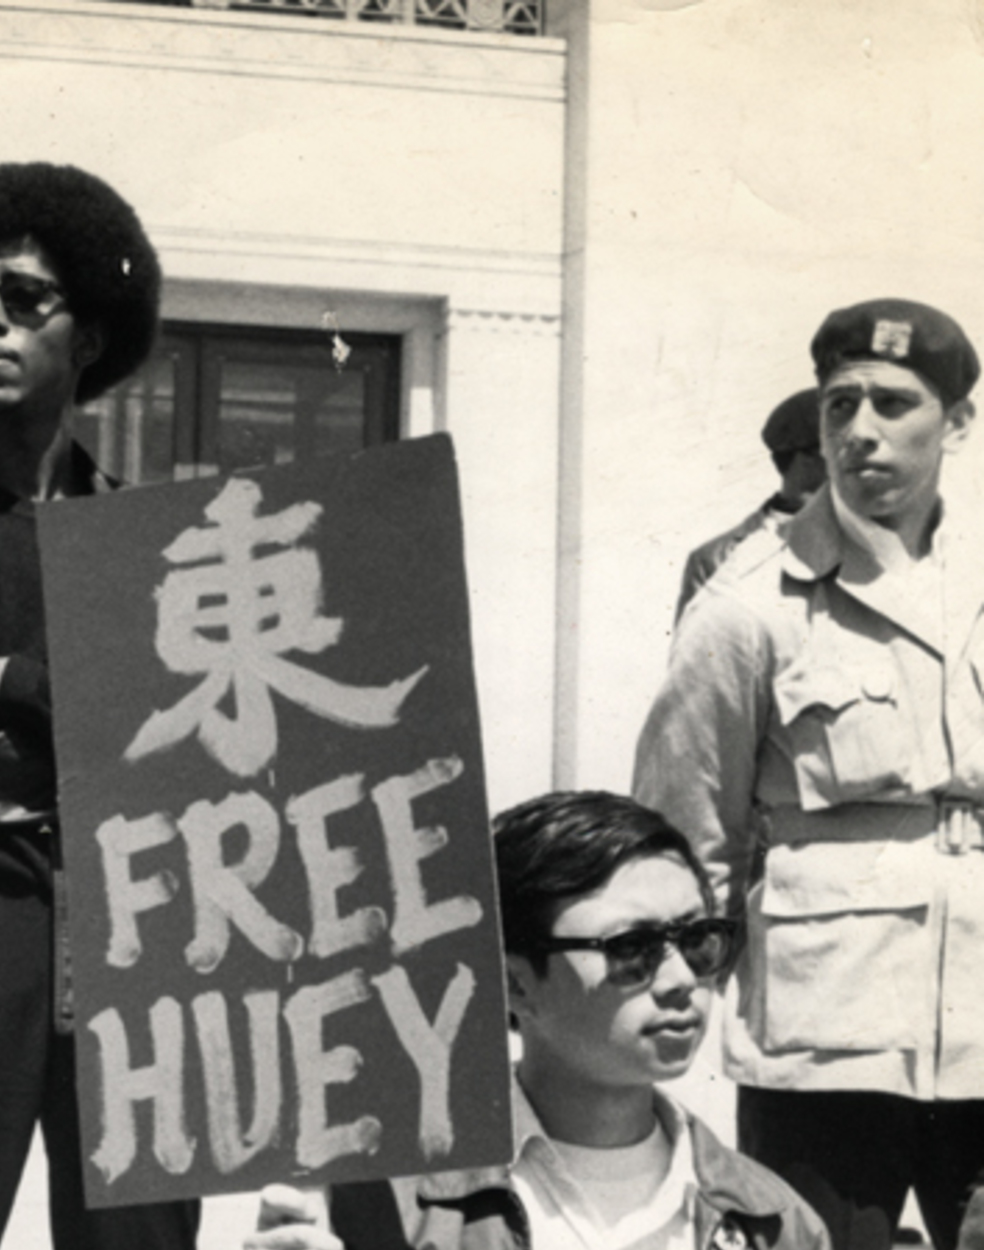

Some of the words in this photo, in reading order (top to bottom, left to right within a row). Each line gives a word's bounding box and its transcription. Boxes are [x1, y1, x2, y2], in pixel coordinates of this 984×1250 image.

[123, 477, 429, 776] 東
[95, 755, 482, 972] FREE
[88, 962, 476, 1183] HUEY
